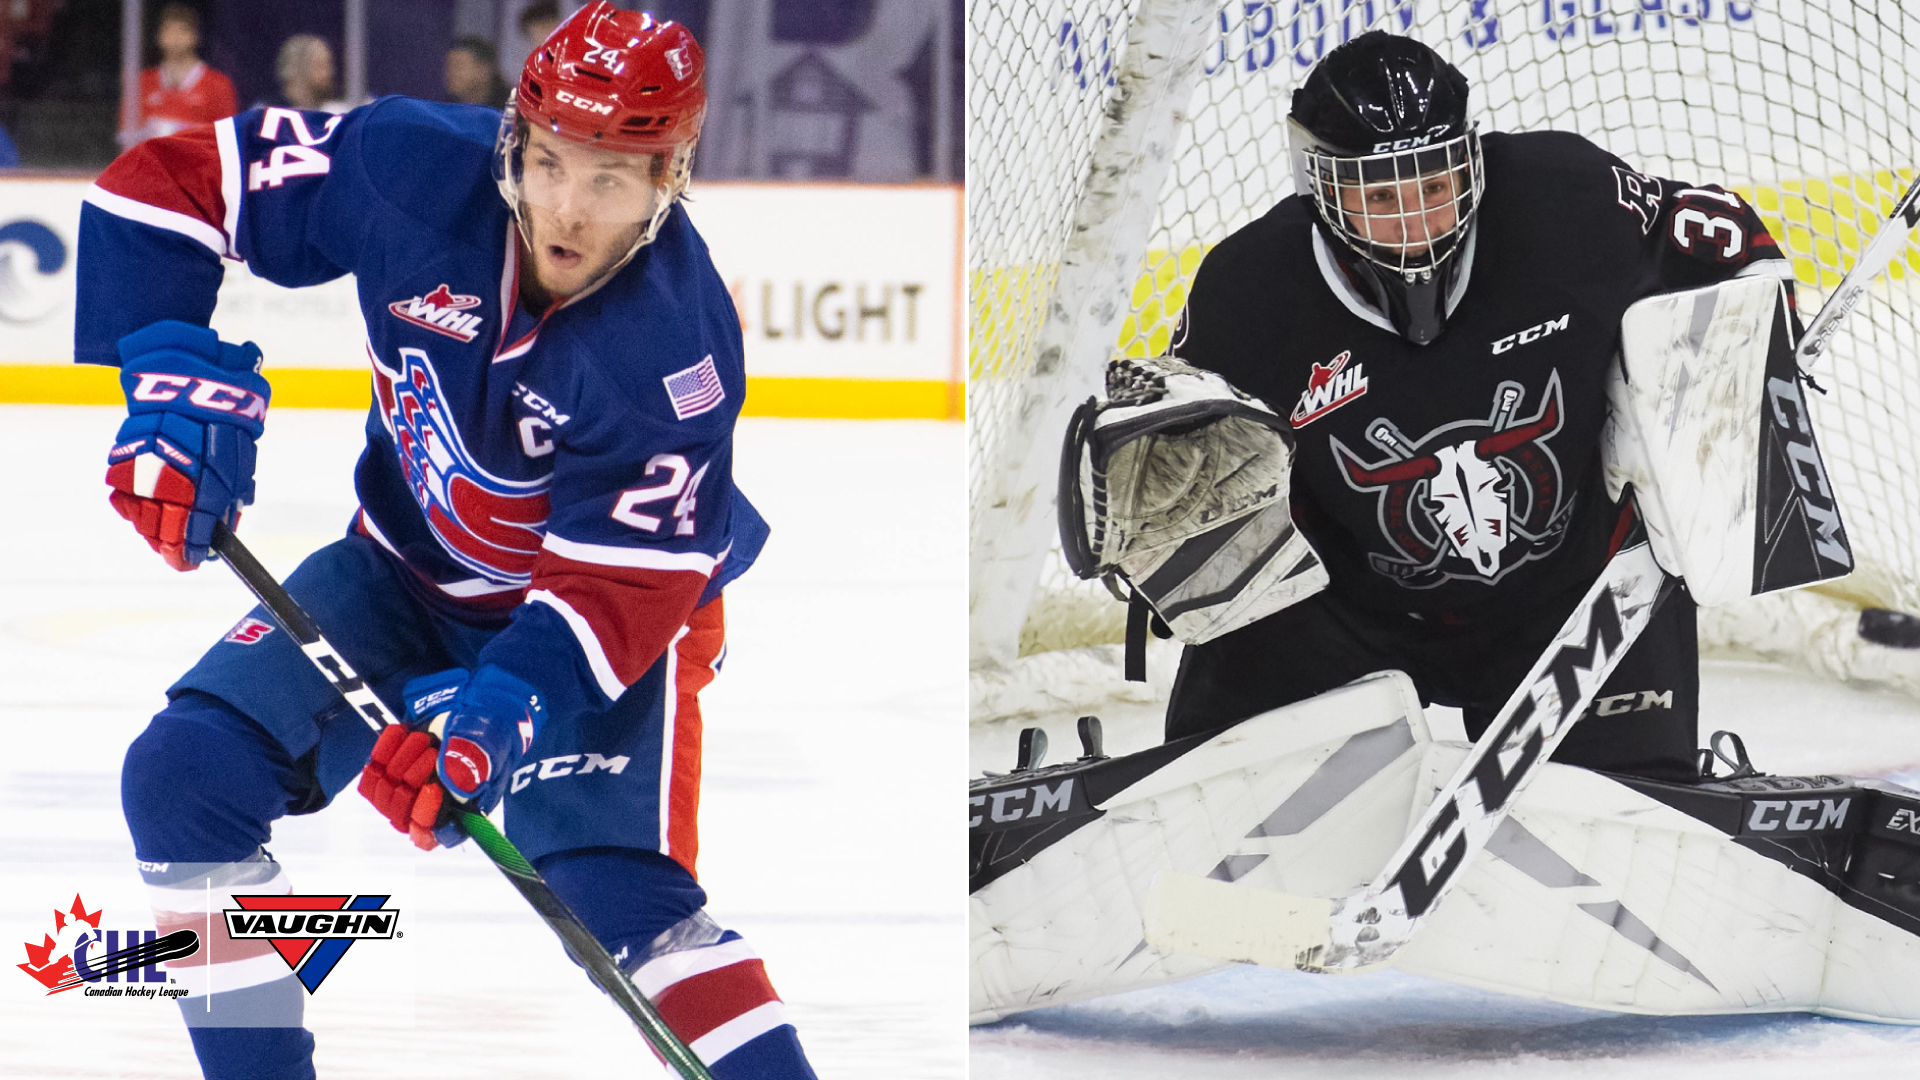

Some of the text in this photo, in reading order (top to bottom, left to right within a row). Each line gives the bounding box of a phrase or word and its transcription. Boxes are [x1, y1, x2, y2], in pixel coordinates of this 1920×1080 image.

[582, 47, 620, 71] 24
[556, 90, 614, 115] CCM
[248, 107, 343, 191] 24
[1373, 136, 1432, 155] CCM
[1673, 188, 1746, 259] 31
[409, 296, 483, 340] WHL
[760, 281, 925, 343] LIGHT
[1813, 285, 1864, 355] PREMIER
[1491, 314, 1570, 355] CCM
[1301, 363, 1368, 415] WHL
[519, 417, 555, 458] C
[611, 453, 710, 535] 24
[1767, 376, 1850, 568] CCM
[301, 634, 401, 731] CC
[413, 686, 459, 710] CCM
[1577, 690, 1673, 721] CM
[1380, 583, 1626, 919] CCM
[510, 754, 631, 795] CCM
[969, 778, 1074, 828] CCM
[1748, 798, 1851, 831] CCM
[1886, 808, 1920, 835] EX
